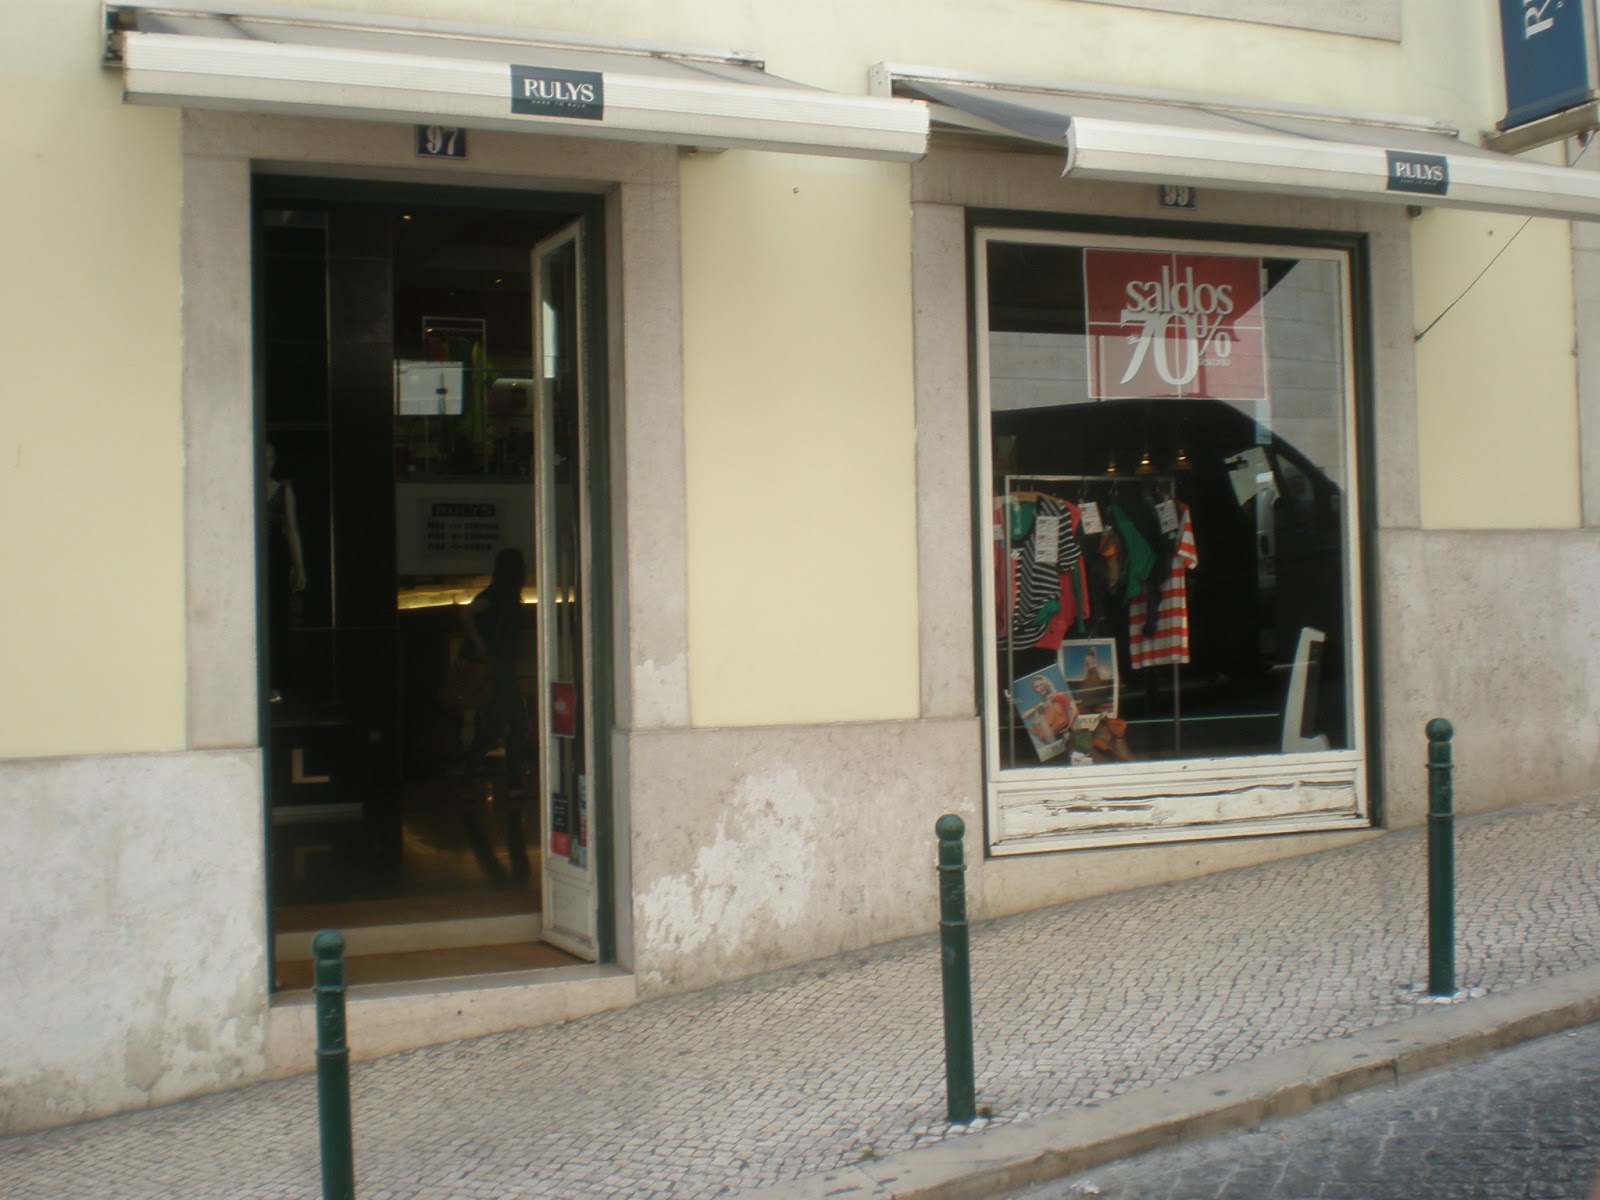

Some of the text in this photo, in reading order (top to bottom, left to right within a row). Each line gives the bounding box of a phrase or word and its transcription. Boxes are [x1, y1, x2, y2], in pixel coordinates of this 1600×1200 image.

[523, 78, 594, 102] RULYS
[426, 126, 457, 155] 97
[1395, 161, 1443, 181] RULYS
[1126, 265, 1233, 315] saldos
[1120, 310, 1231, 386] 70%
